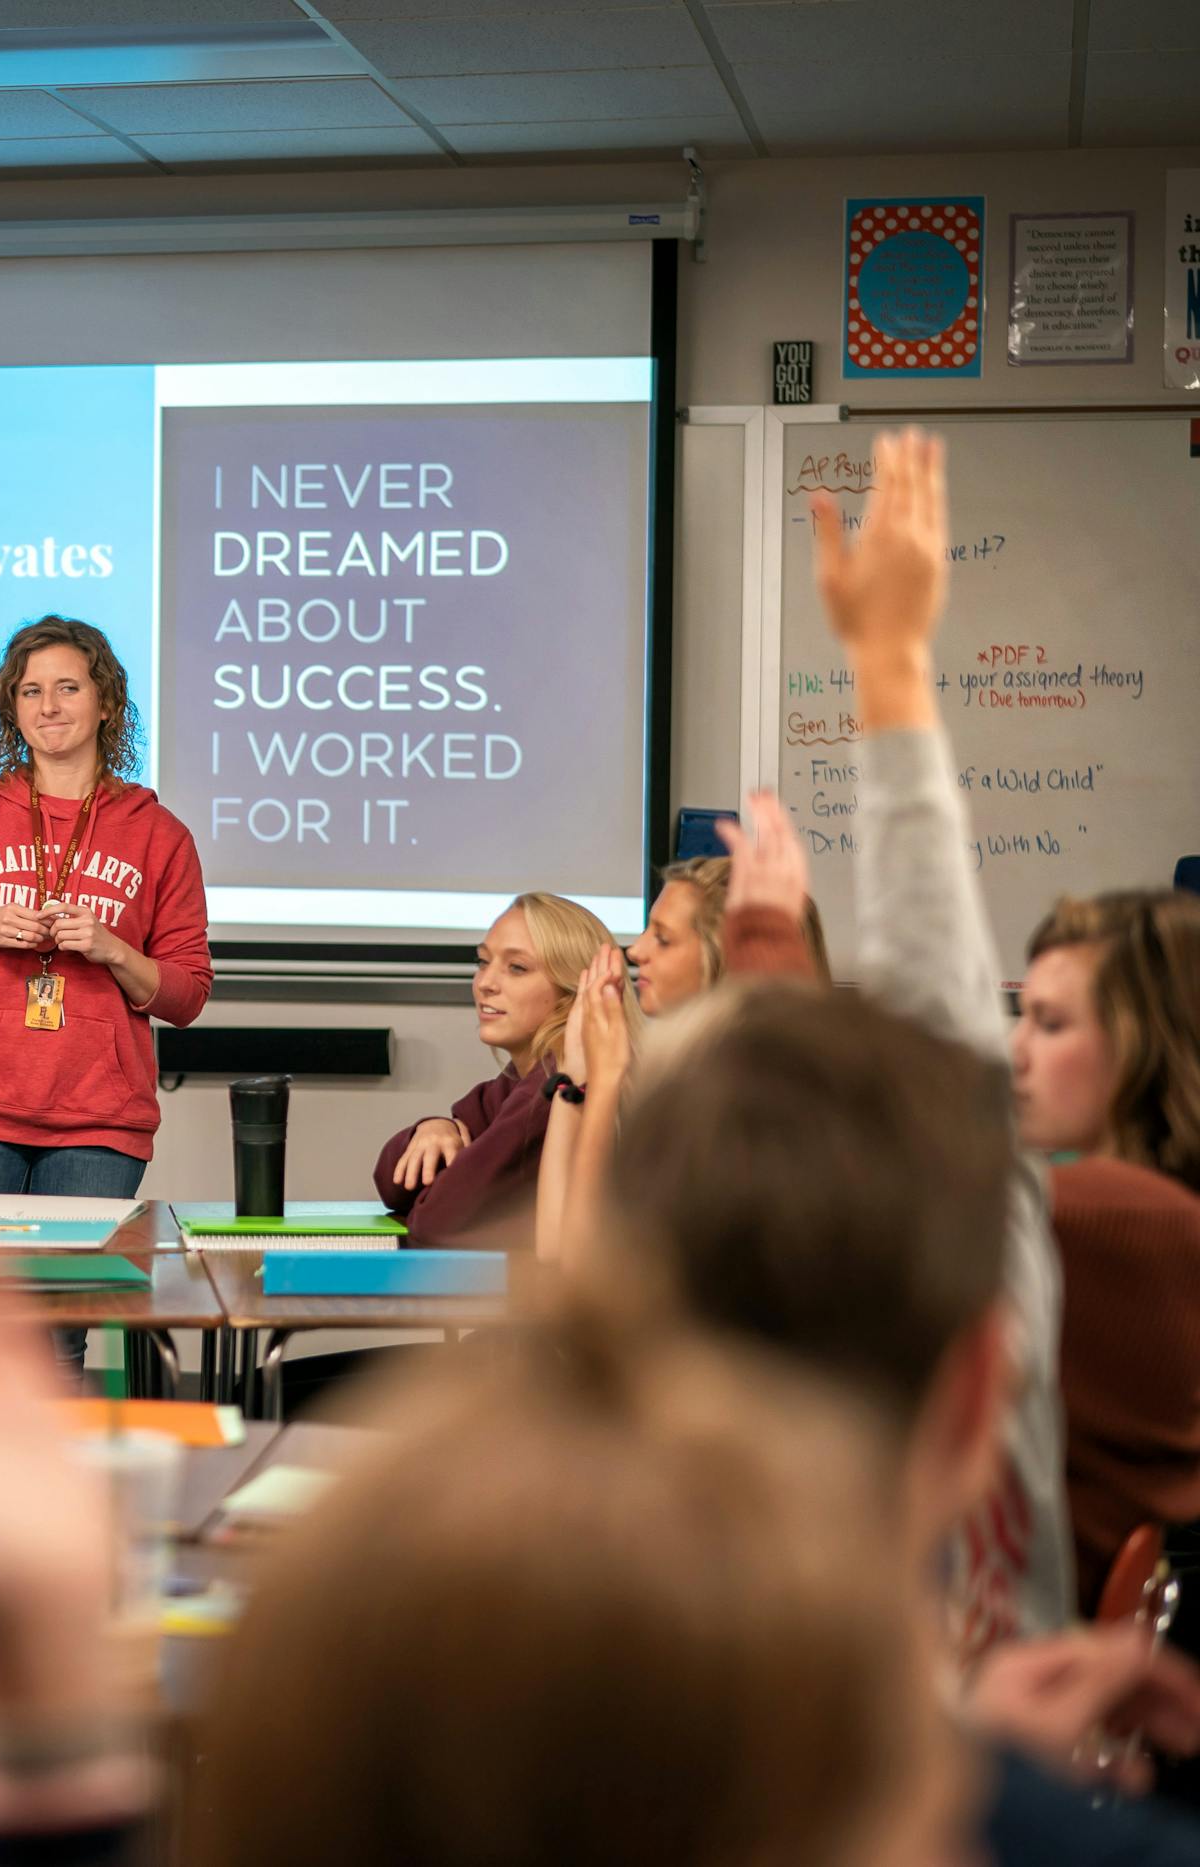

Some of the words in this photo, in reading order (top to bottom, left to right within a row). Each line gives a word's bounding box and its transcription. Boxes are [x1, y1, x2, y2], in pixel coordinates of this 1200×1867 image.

[776, 343, 810, 363] YOU
[776, 363, 810, 384] GOT
[776, 384, 810, 402] THIS
[215, 465, 222, 509] I
[251, 463, 454, 509] NEVER
[797, 455, 829, 482] AP
[213, 530, 510, 576] DREAMED
[214, 598, 427, 643] ABOUT
[213, 664, 502, 712] SUCCESS.
[960, 671, 997, 707] your
[1003, 663, 1082, 691] assigned
[1089, 663, 1143, 700] theory
[212, 731, 219, 775] I
[247, 731, 523, 780] WORKED
[997, 767, 1041, 793] Wild
[211, 797, 331, 844] FOR
[362, 799, 418, 845] IT.
[987, 834, 1030, 856] With
